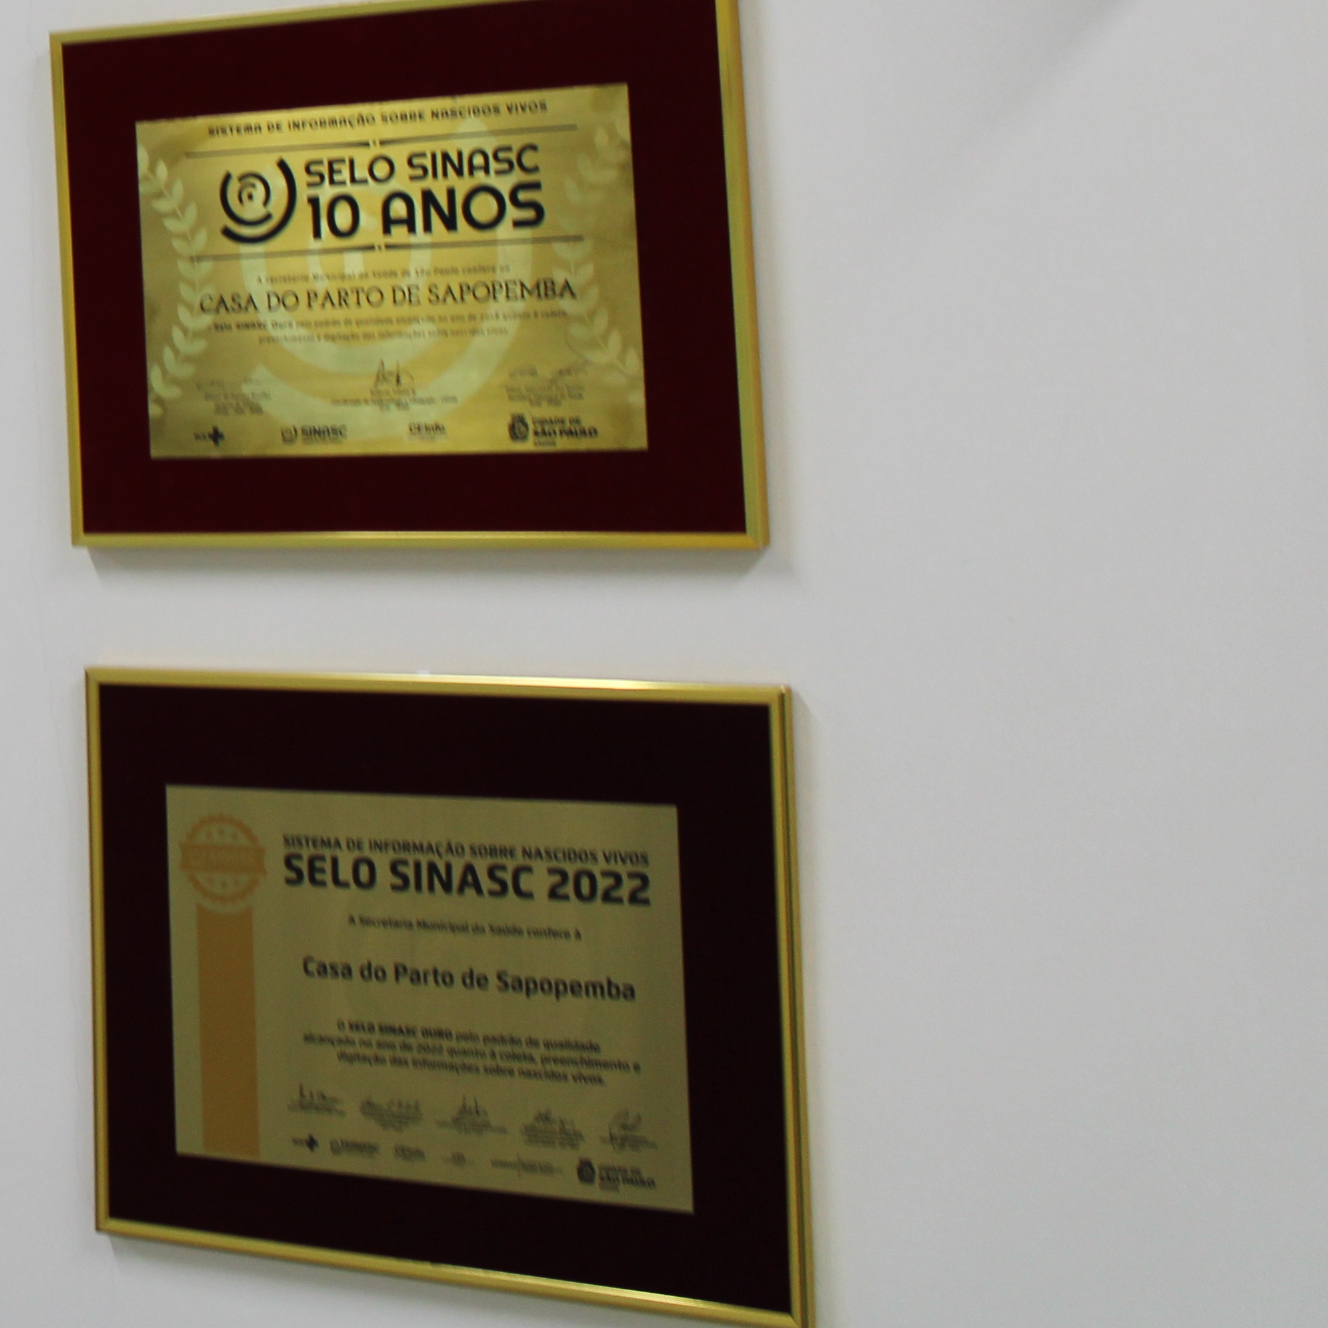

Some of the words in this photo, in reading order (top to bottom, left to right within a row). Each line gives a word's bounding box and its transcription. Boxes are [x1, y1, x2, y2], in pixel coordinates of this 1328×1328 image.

[207, 122, 262, 139] SISTEMA
[266, 120, 283, 134] DE
[287, 111, 376, 134] INFORMAÇÃO
[380, 109, 425, 126] SOBRE
[430, 103, 501, 122] NASCIDOS
[505, 100, 548, 116] VIVOS
[303, 152, 396, 188] SELO
[405, 141, 540, 182] SINASC
[307, 192, 362, 240] 10
[379, 180, 546, 236] ANOS
[198, 290, 260, 316] CASA
[266, 288, 300, 313] DO
[305, 284, 385, 311] PARTO
[391, 282, 421, 307] DE
[426, 275, 577, 305] SAPOPEMBA
[283, 832, 342, 852] SISTEMA
[346, 835, 366, 853] DE
[368, 834, 465, 860] INFORMAÇÃO
[468, 842, 516, 861] SOBRE
[521, 844, 598, 865] NASCIDOS
[602, 848, 650, 868] VIVOS
[283, 852, 377, 890] SELO
[388, 858, 535, 900] SINASC
[546, 867, 652, 907] 2022
[301, 954, 353, 984] Casa
[359, 958, 387, 986] do
[393, 961, 455, 992] Parto
[461, 966, 490, 994] de
[495, 968, 636, 1006] Sapopemba
